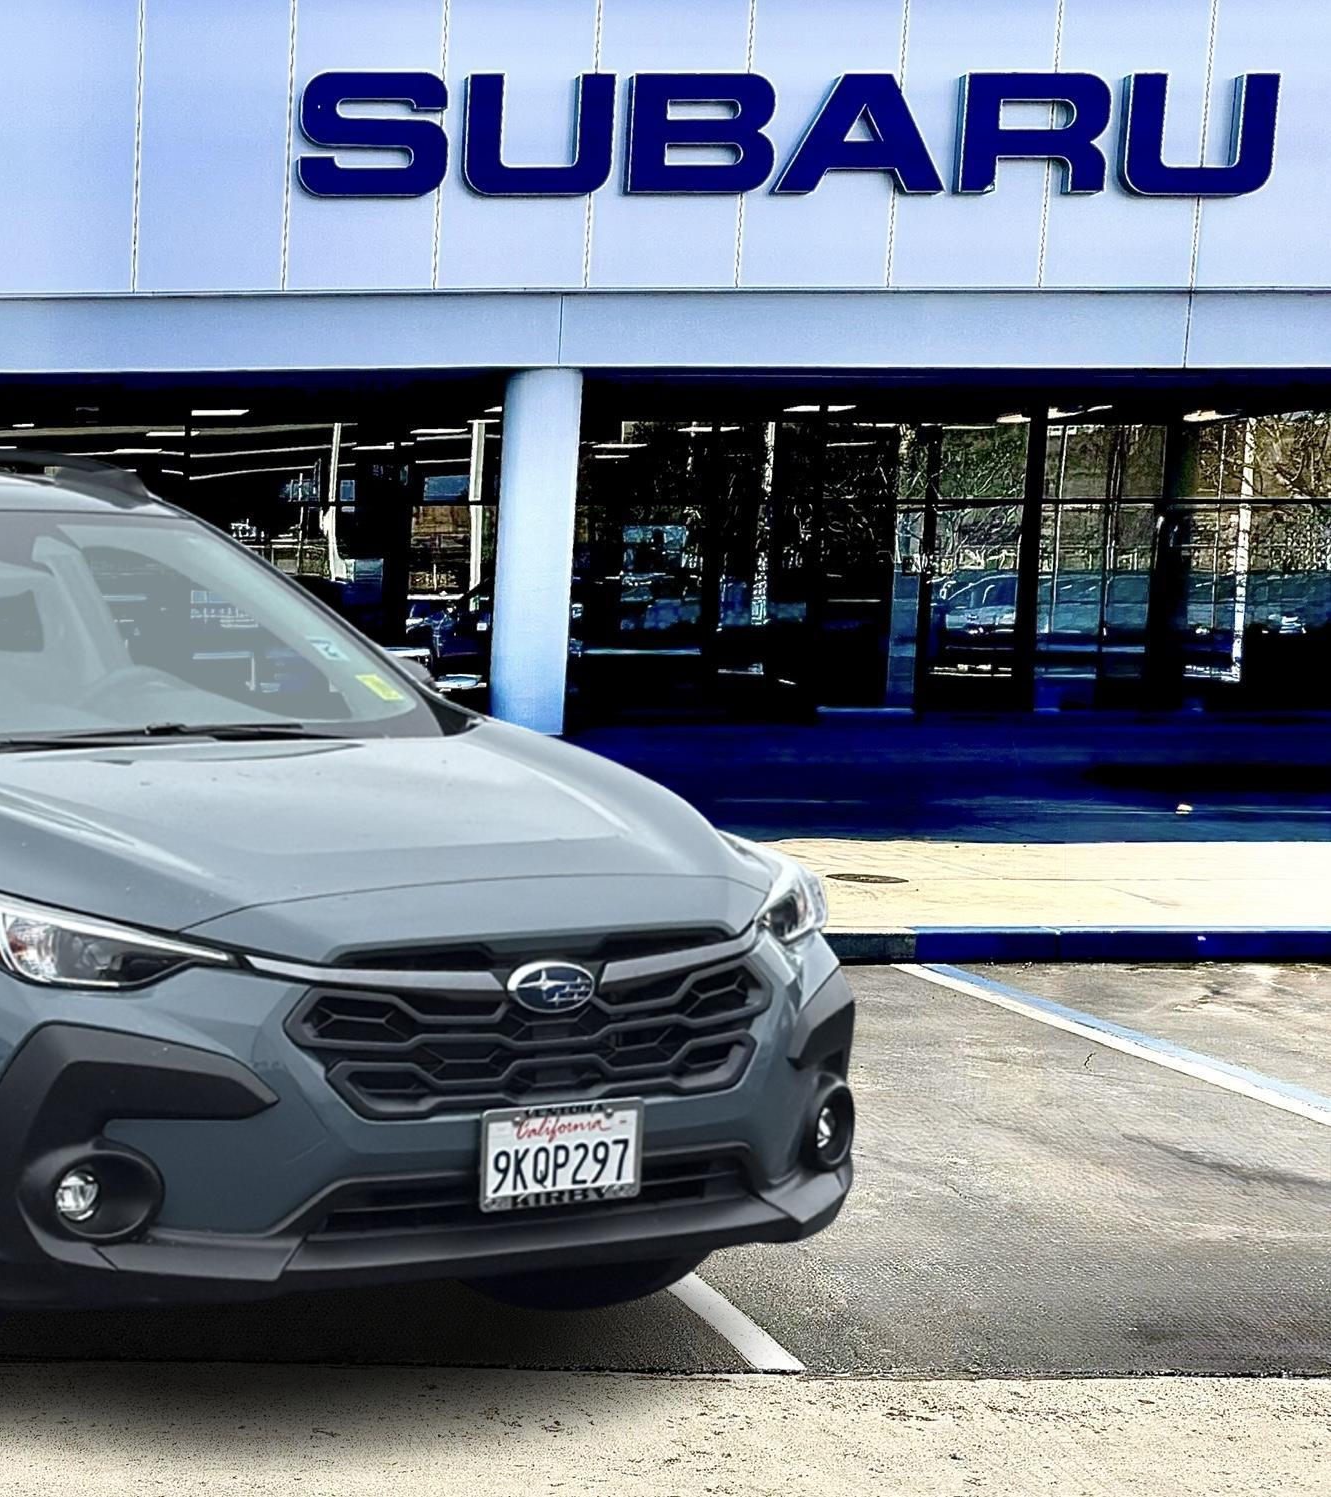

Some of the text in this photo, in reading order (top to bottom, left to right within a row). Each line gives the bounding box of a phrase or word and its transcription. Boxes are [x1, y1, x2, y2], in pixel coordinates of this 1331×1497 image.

[297, 70, 1281, 198] SUBARU
[516, 1113, 611, 1143] California
[492, 1138, 630, 1194] 9KQP297
[512, 1187, 609, 1208] KIRBY
